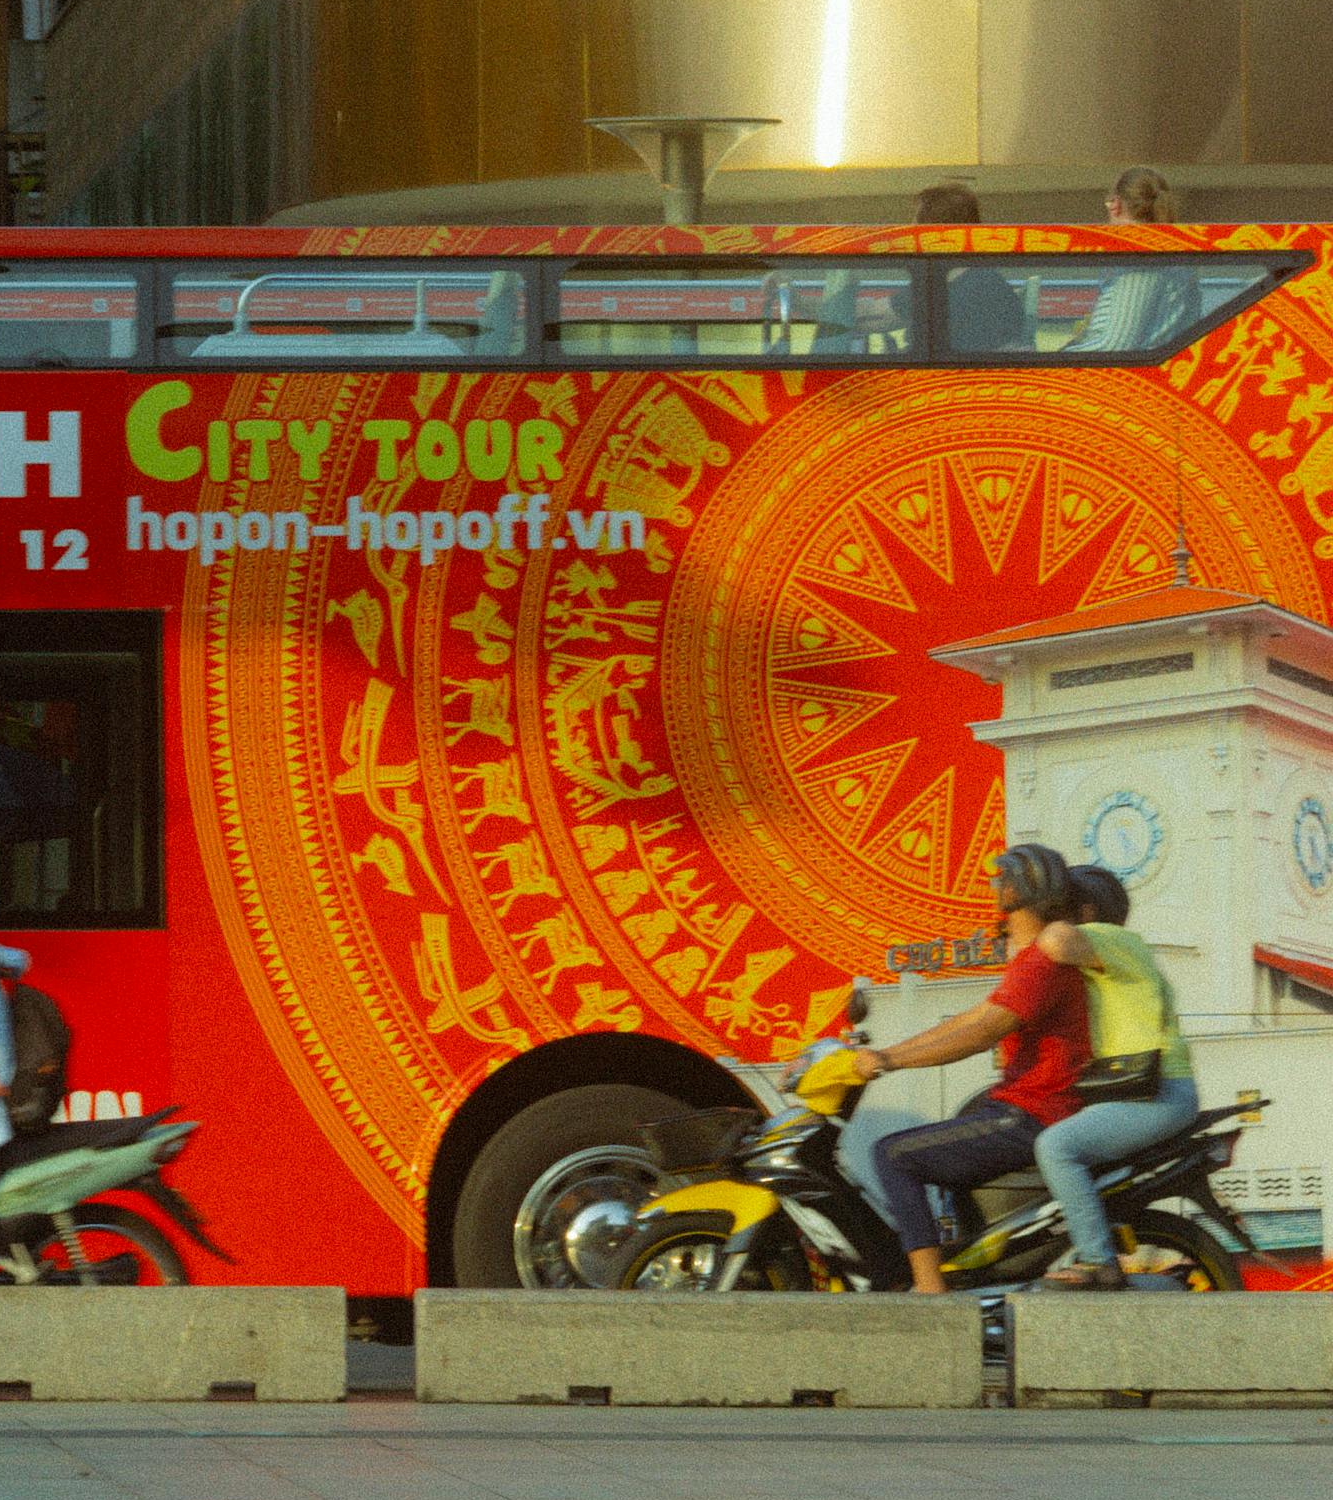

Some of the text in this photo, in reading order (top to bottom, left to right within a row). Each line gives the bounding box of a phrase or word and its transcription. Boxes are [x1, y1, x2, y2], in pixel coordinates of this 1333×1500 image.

[126, 380, 565, 483] CITY TOUR
[18, 528, 90, 571] 12
[126, 494, 645, 566] hopon-hopoff.vn
